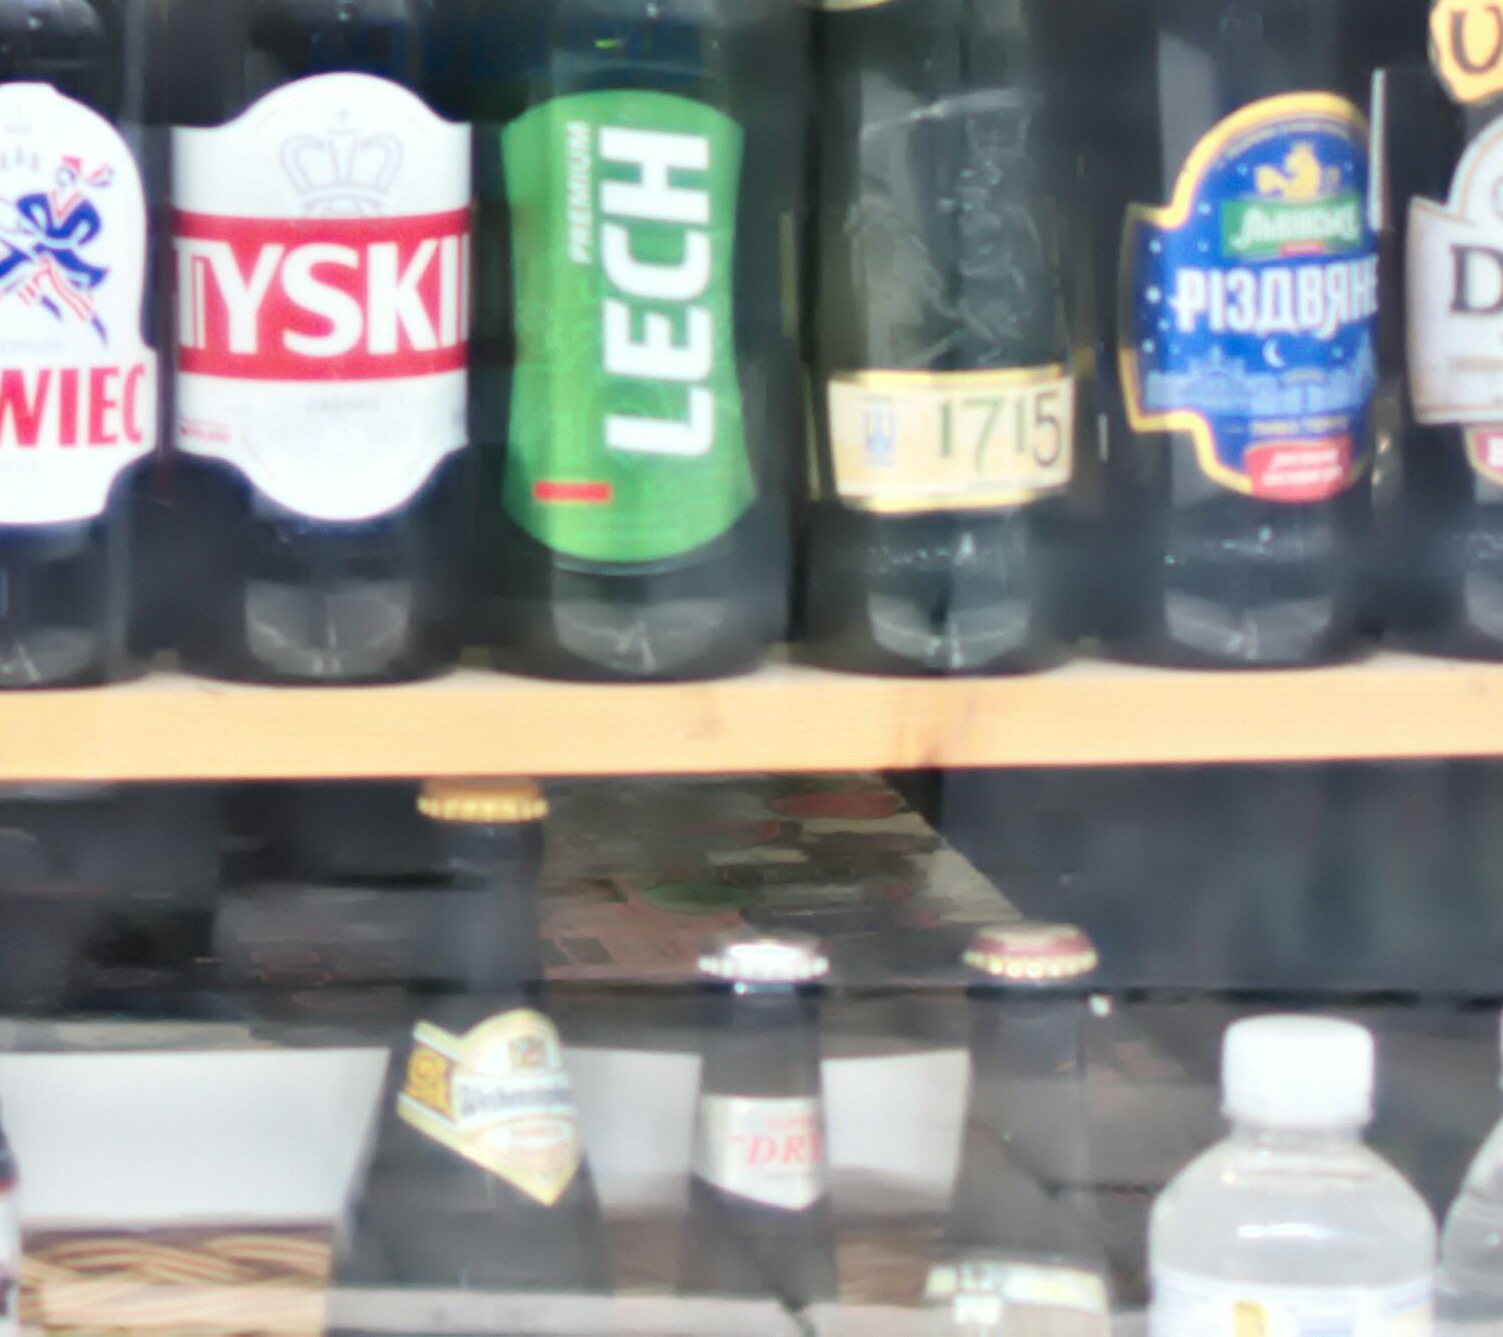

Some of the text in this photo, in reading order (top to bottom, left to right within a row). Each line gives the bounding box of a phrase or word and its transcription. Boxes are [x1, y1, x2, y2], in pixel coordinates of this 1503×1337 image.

[565, 120, 594, 265] PREMIUM
[172, 230, 471, 357] TYSKI
[597, 124, 717, 458] LECH
[937, 388, 1063, 476] 1715
